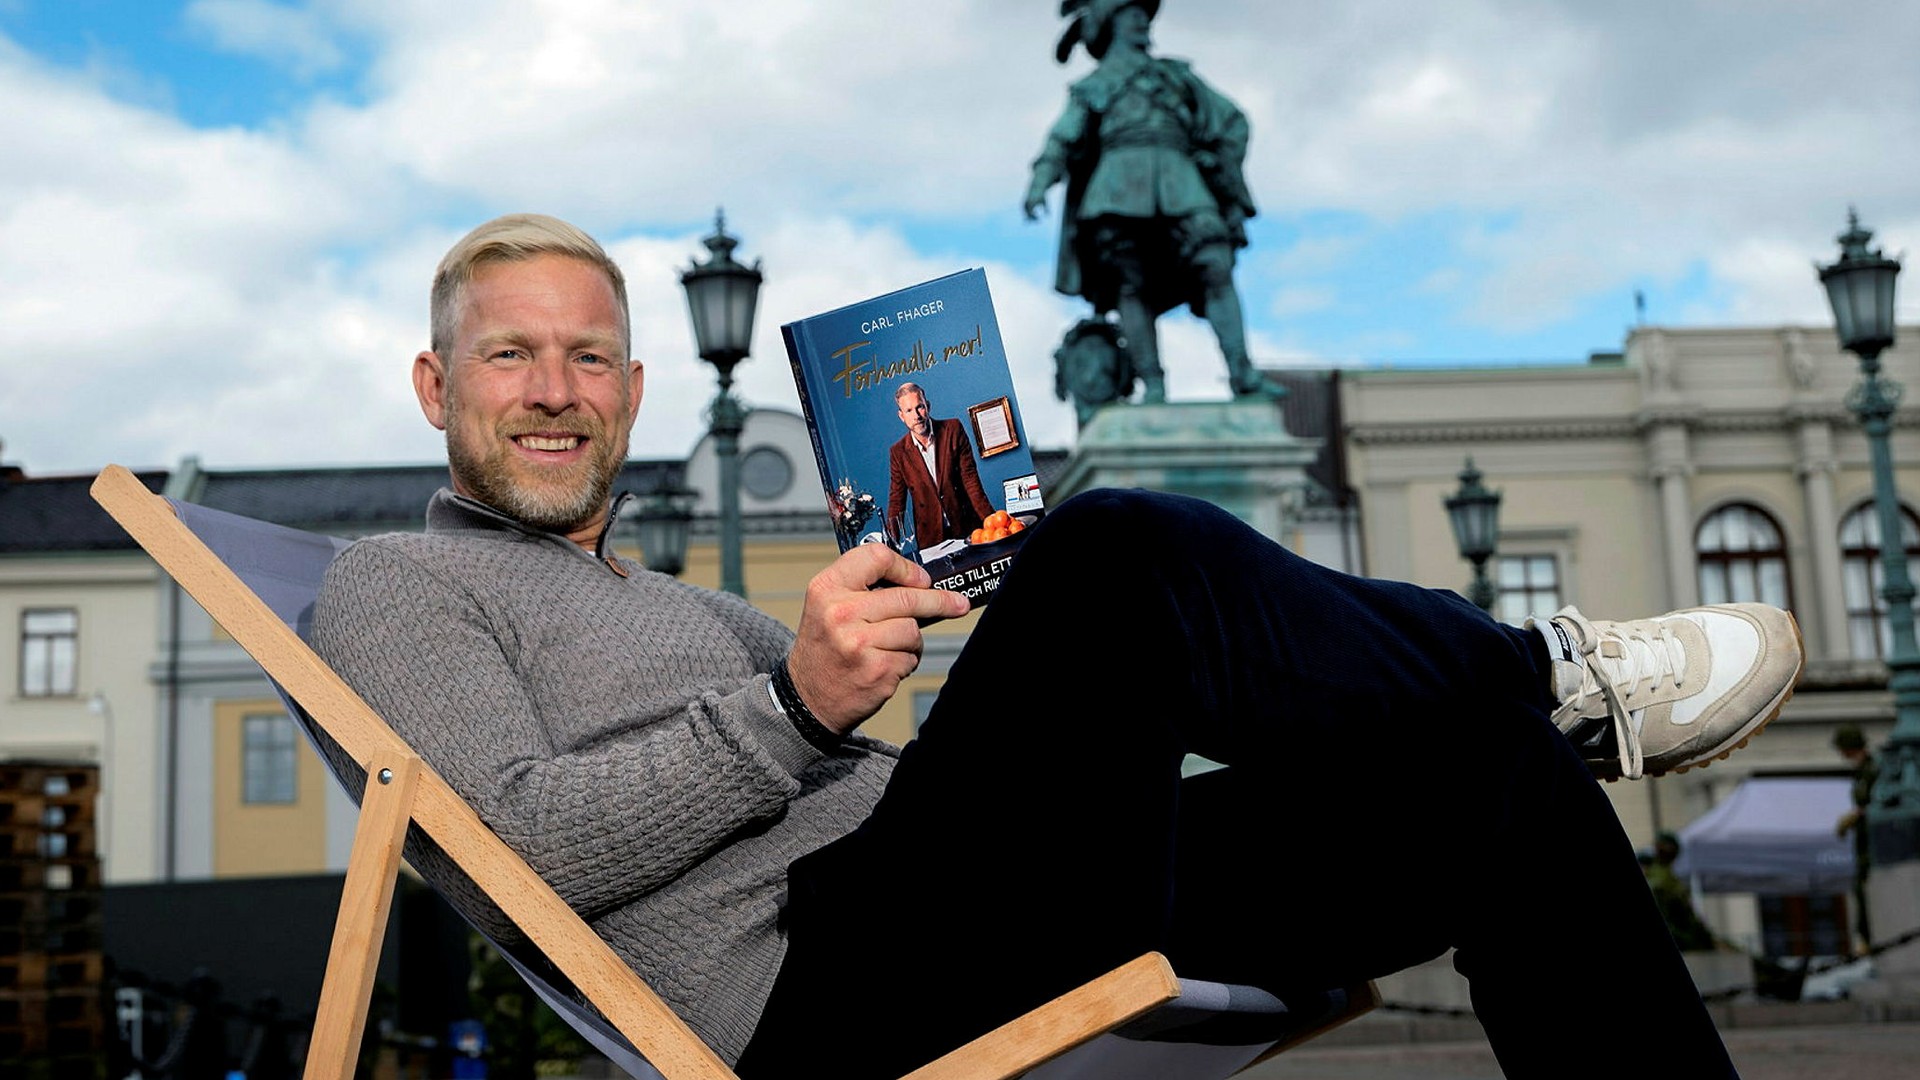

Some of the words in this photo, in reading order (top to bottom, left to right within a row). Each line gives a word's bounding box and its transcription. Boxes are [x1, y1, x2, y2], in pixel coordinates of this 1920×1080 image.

[861, 316, 894, 335] CARL
[896, 300, 945, 324] FHAGER
[831, 339, 938, 398] Förhandla
[943, 325, 982, 362] mer!
[933, 574, 965, 591] STEG
[965, 565, 990, 582] TILL
[990, 556, 1012, 574] ETT
